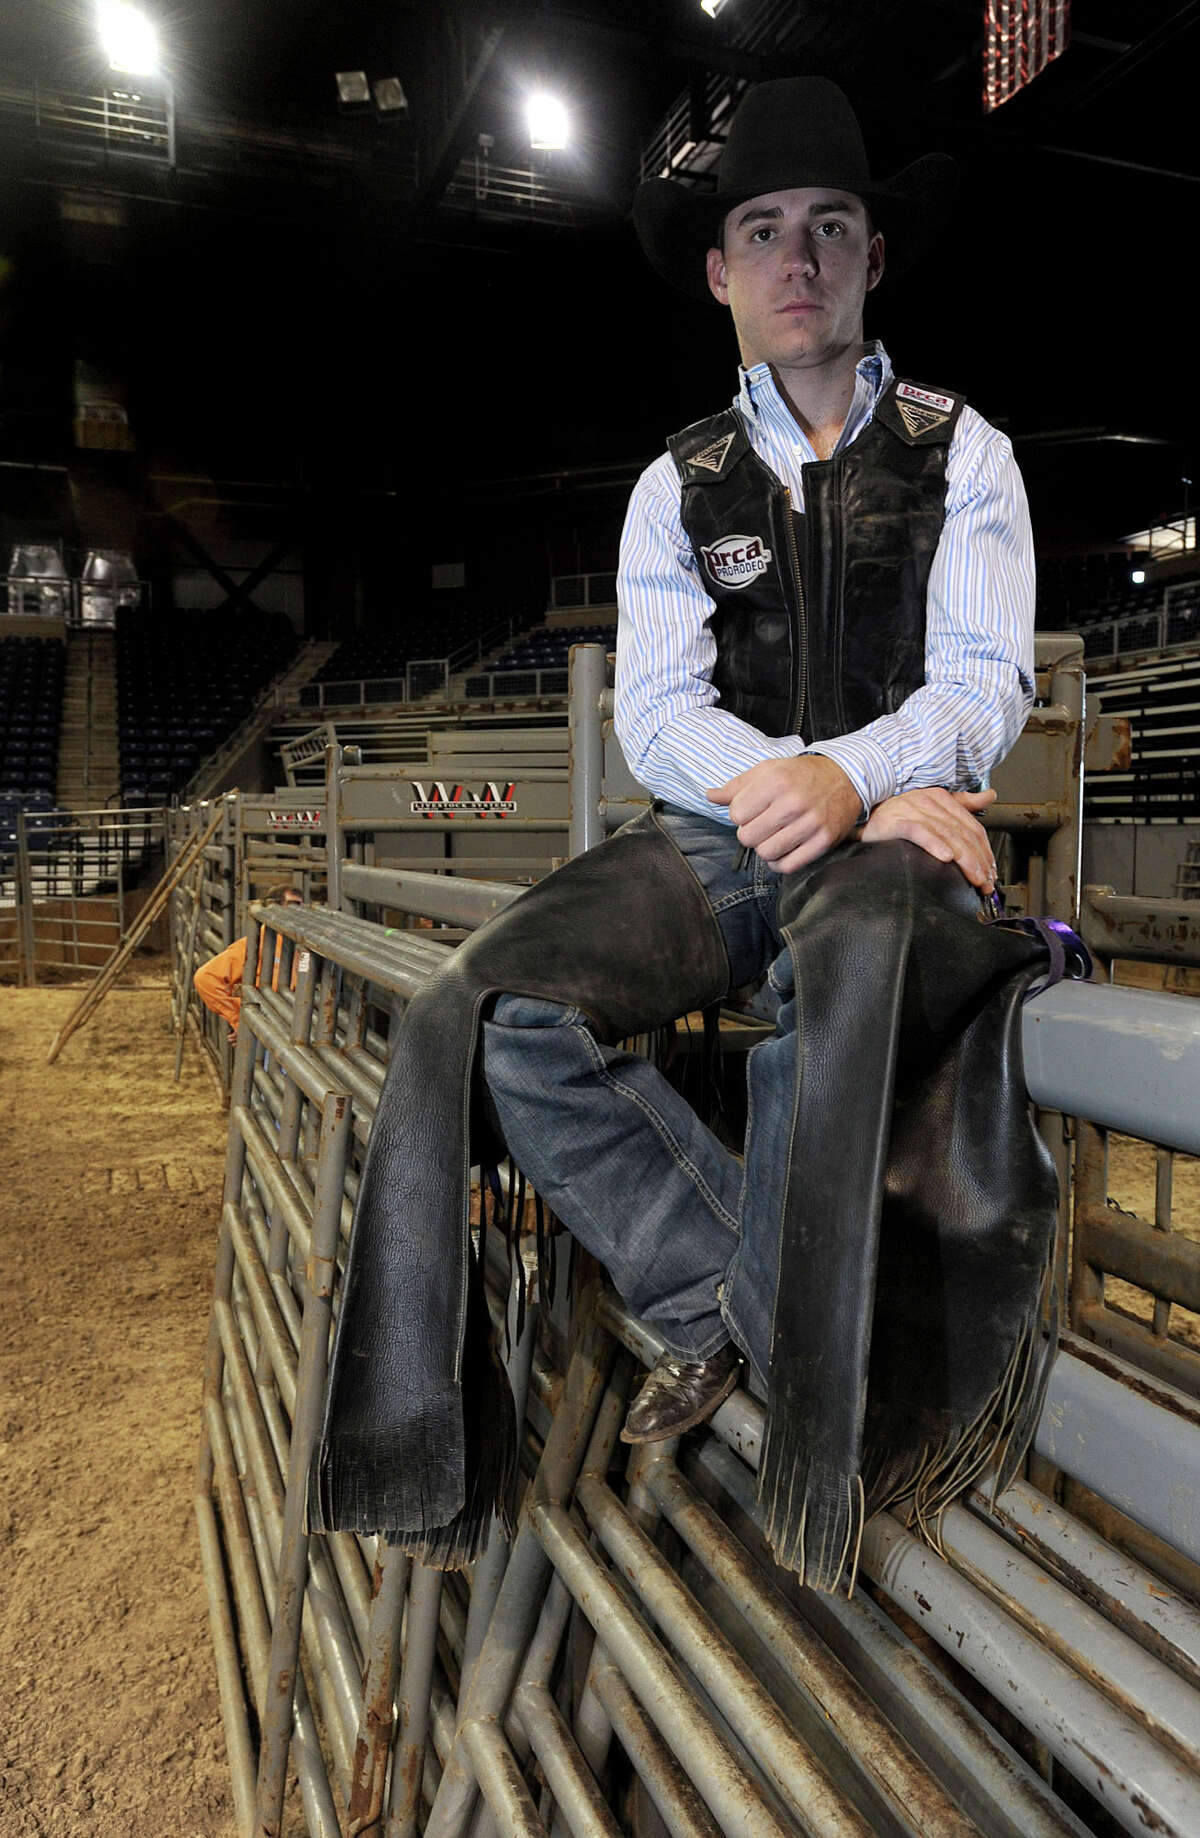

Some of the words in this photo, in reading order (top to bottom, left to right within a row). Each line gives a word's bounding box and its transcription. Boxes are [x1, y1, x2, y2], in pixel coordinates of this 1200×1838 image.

[903, 385, 948, 405] prca
[703, 540, 761, 579] prca
[716, 560, 764, 577] PRORODEO
